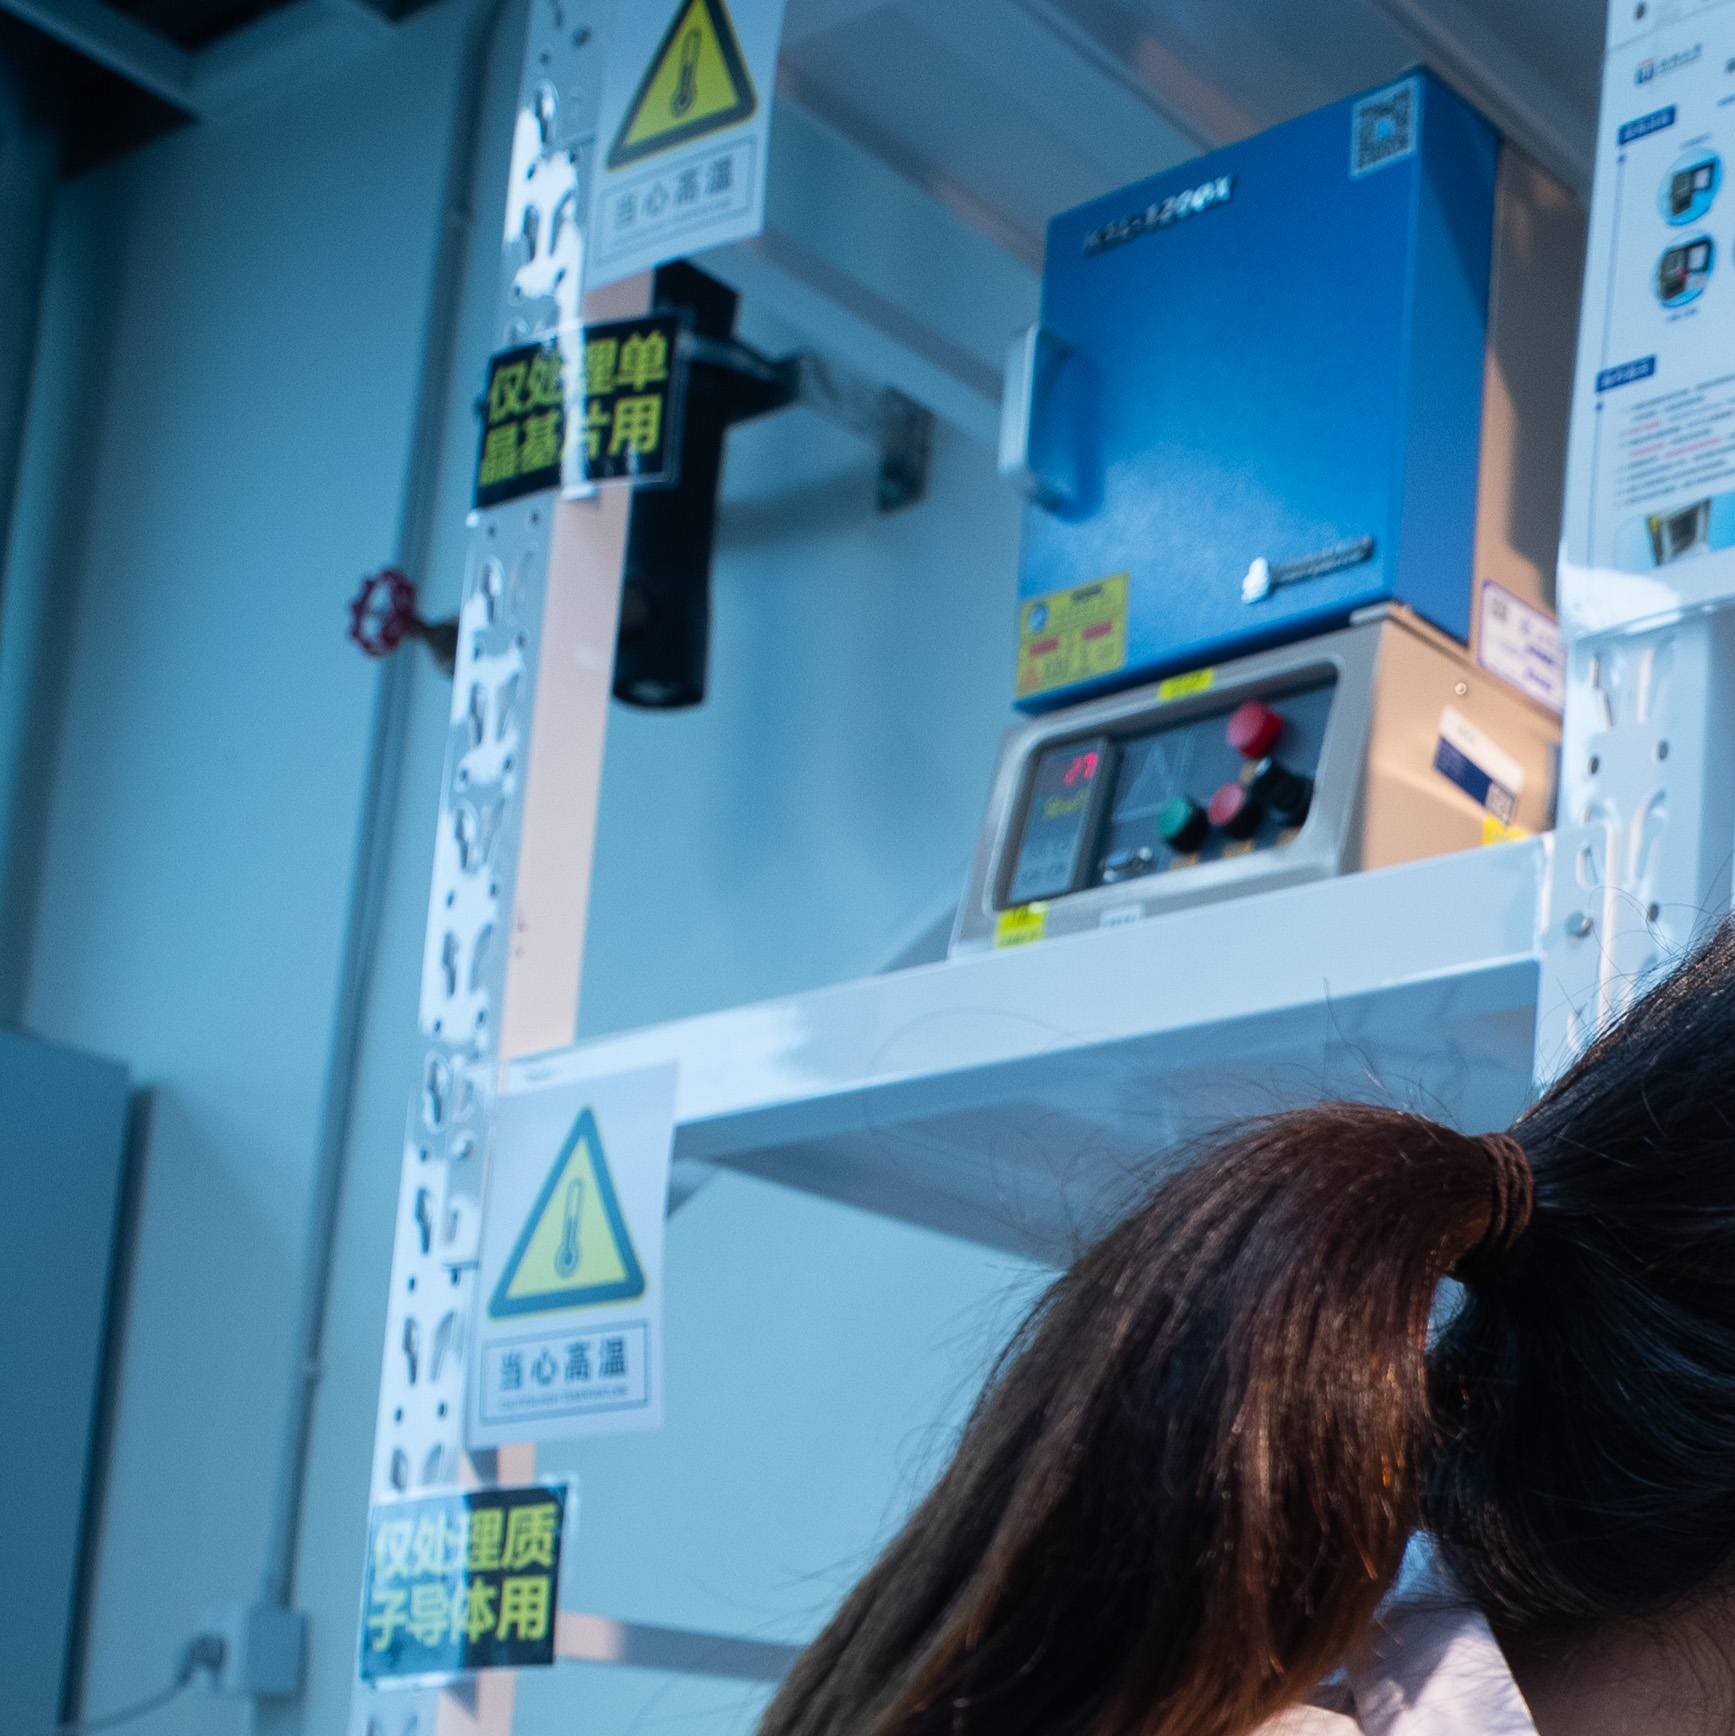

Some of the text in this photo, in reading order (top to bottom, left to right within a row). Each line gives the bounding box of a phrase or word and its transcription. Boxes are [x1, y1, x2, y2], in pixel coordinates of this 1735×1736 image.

[501, 1337, 627, 1390] 当心高温
[373, 1502, 560, 1580] 仅处理质
[367, 1574, 552, 1652] 子导体用
